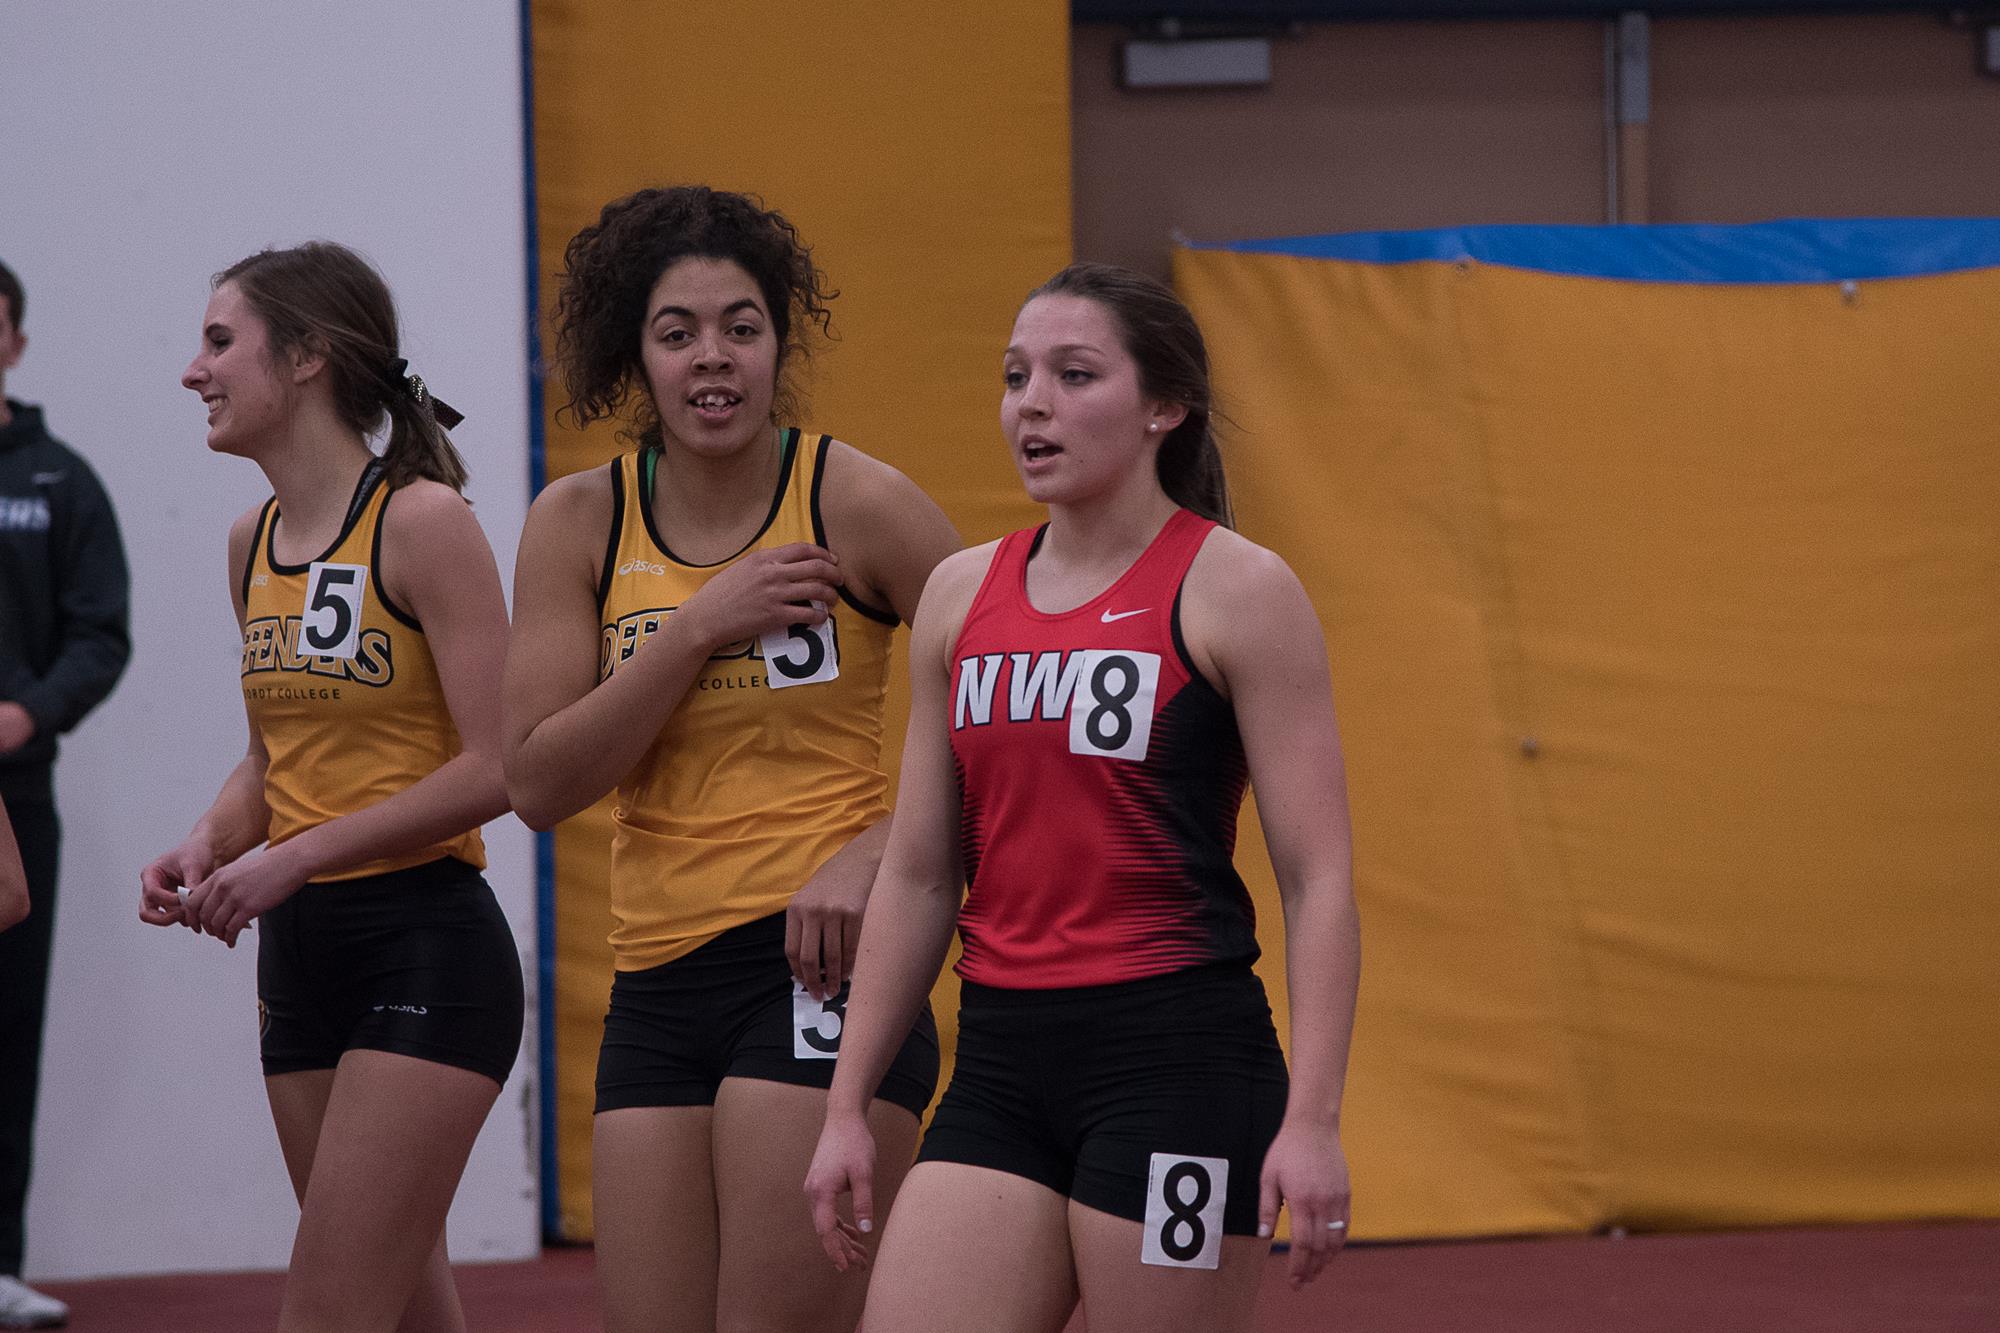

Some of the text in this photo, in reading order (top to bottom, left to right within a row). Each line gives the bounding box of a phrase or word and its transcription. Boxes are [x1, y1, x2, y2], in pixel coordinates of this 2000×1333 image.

[632, 559, 666, 576] asics
[306, 568, 355, 650] 5
[244, 687, 341, 700] ORDT COLLEGE
[699, 676, 770, 690] COLLE
[954, 649, 1085, 732] NW
[1085, 655, 1140, 751] 8
[1160, 1161, 1211, 1262] 8
